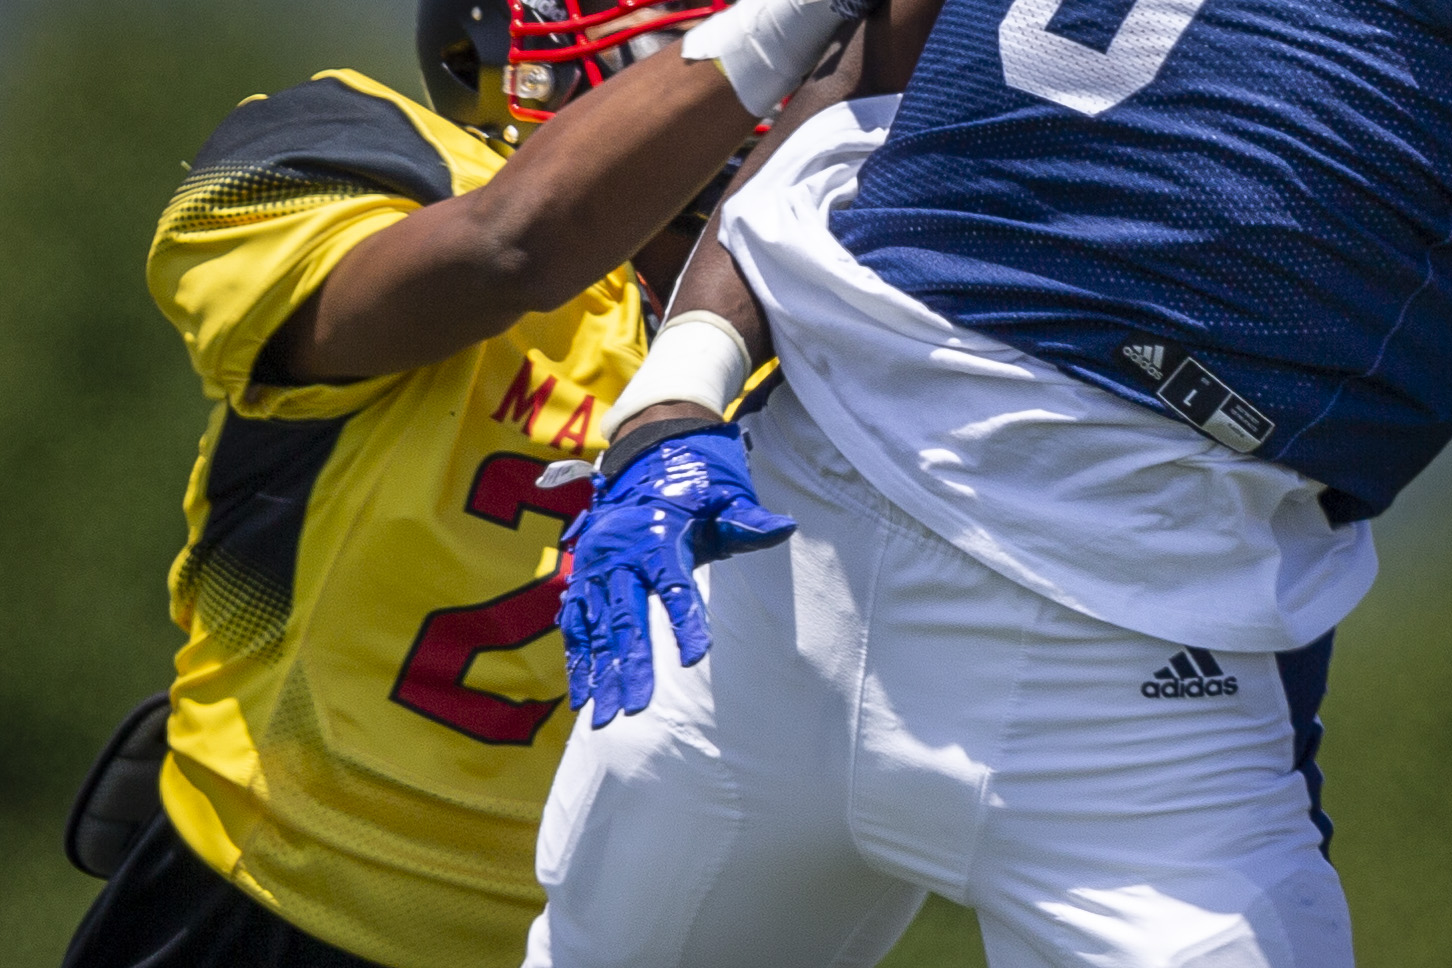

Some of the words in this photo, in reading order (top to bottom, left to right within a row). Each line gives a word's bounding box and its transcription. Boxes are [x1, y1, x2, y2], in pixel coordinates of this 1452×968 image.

[1122, 345, 1164, 381] adidas
[490, 354, 596, 457] MA
[1182, 388, 1199, 407] L
[1140, 675, 1240, 699] adidas
